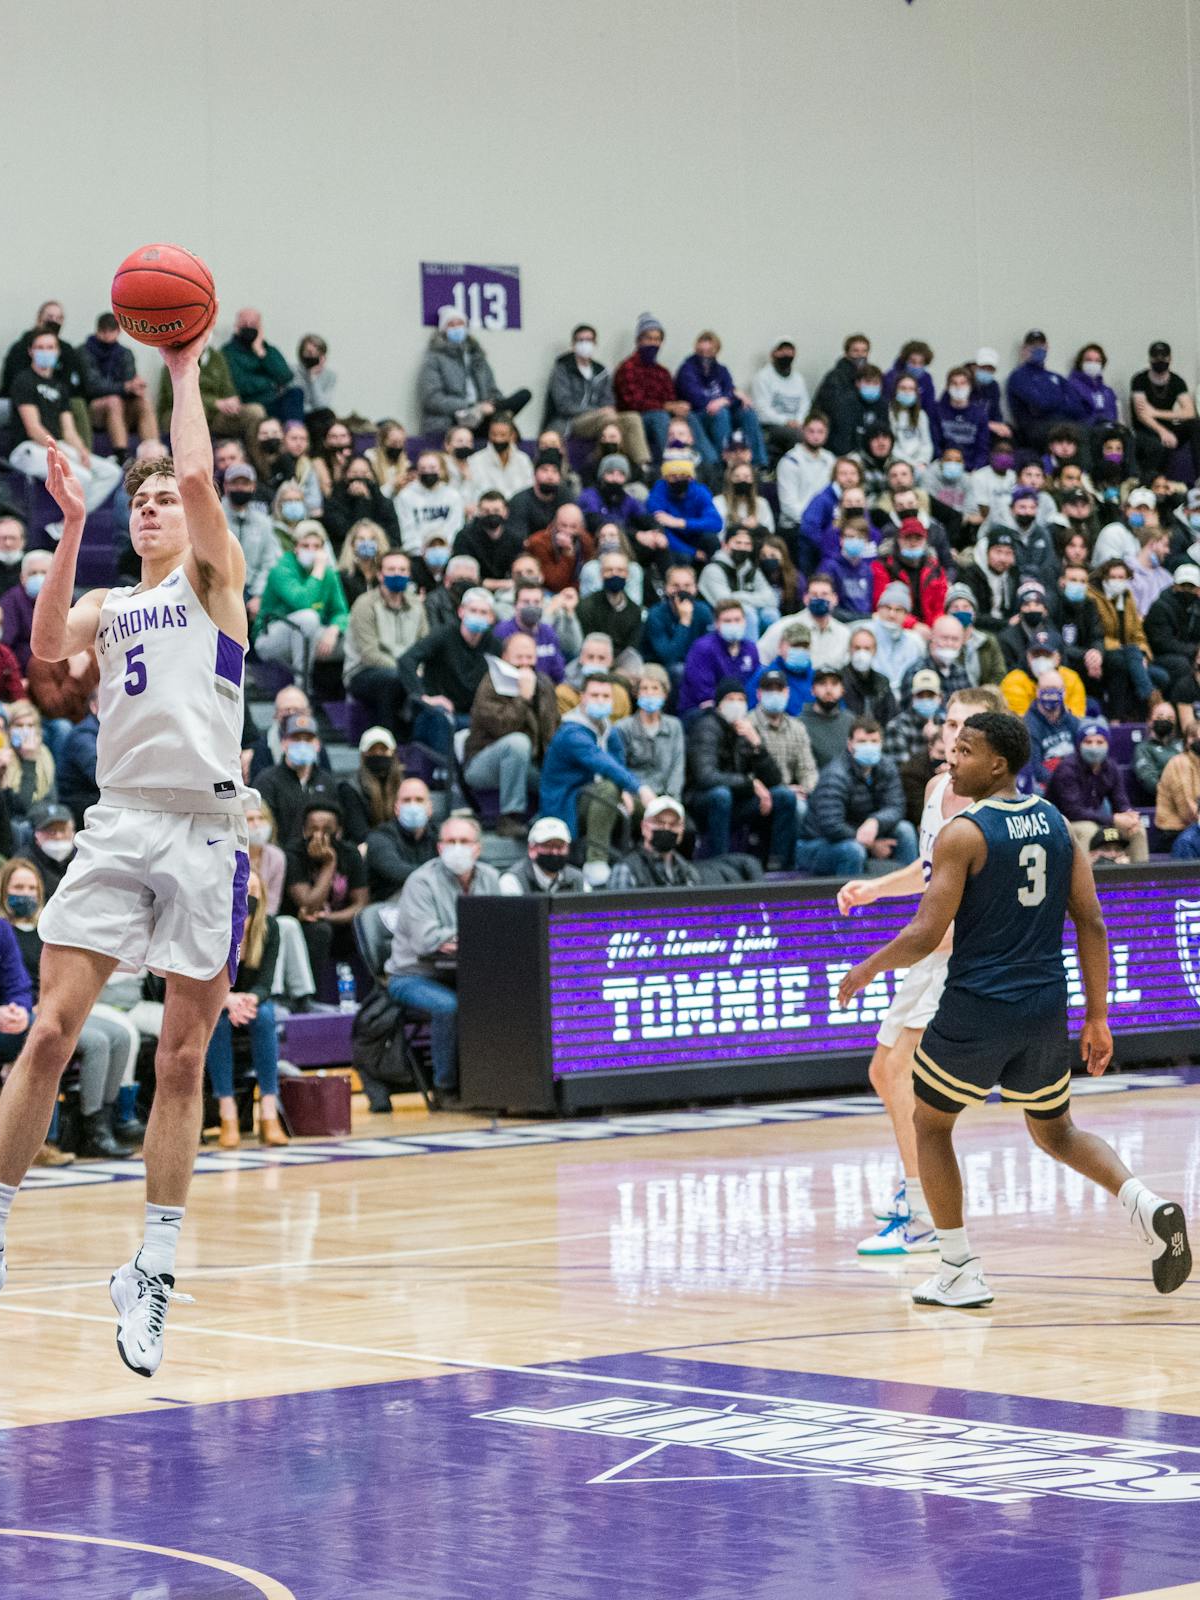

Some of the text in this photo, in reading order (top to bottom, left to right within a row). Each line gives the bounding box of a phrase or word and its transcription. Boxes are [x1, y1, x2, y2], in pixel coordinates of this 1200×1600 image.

[119, 312, 184, 334] Wilson
[112, 605, 187, 644] THOMAS
[124, 653, 147, 697] 5
[1005, 811, 1051, 840] ABMAS
[1017, 843, 1047, 907] 3
[603, 966, 811, 1042] TOMMIE
[758, 1405, 1180, 1461] LEAGUE
[832, 1476, 1049, 1503] THE
